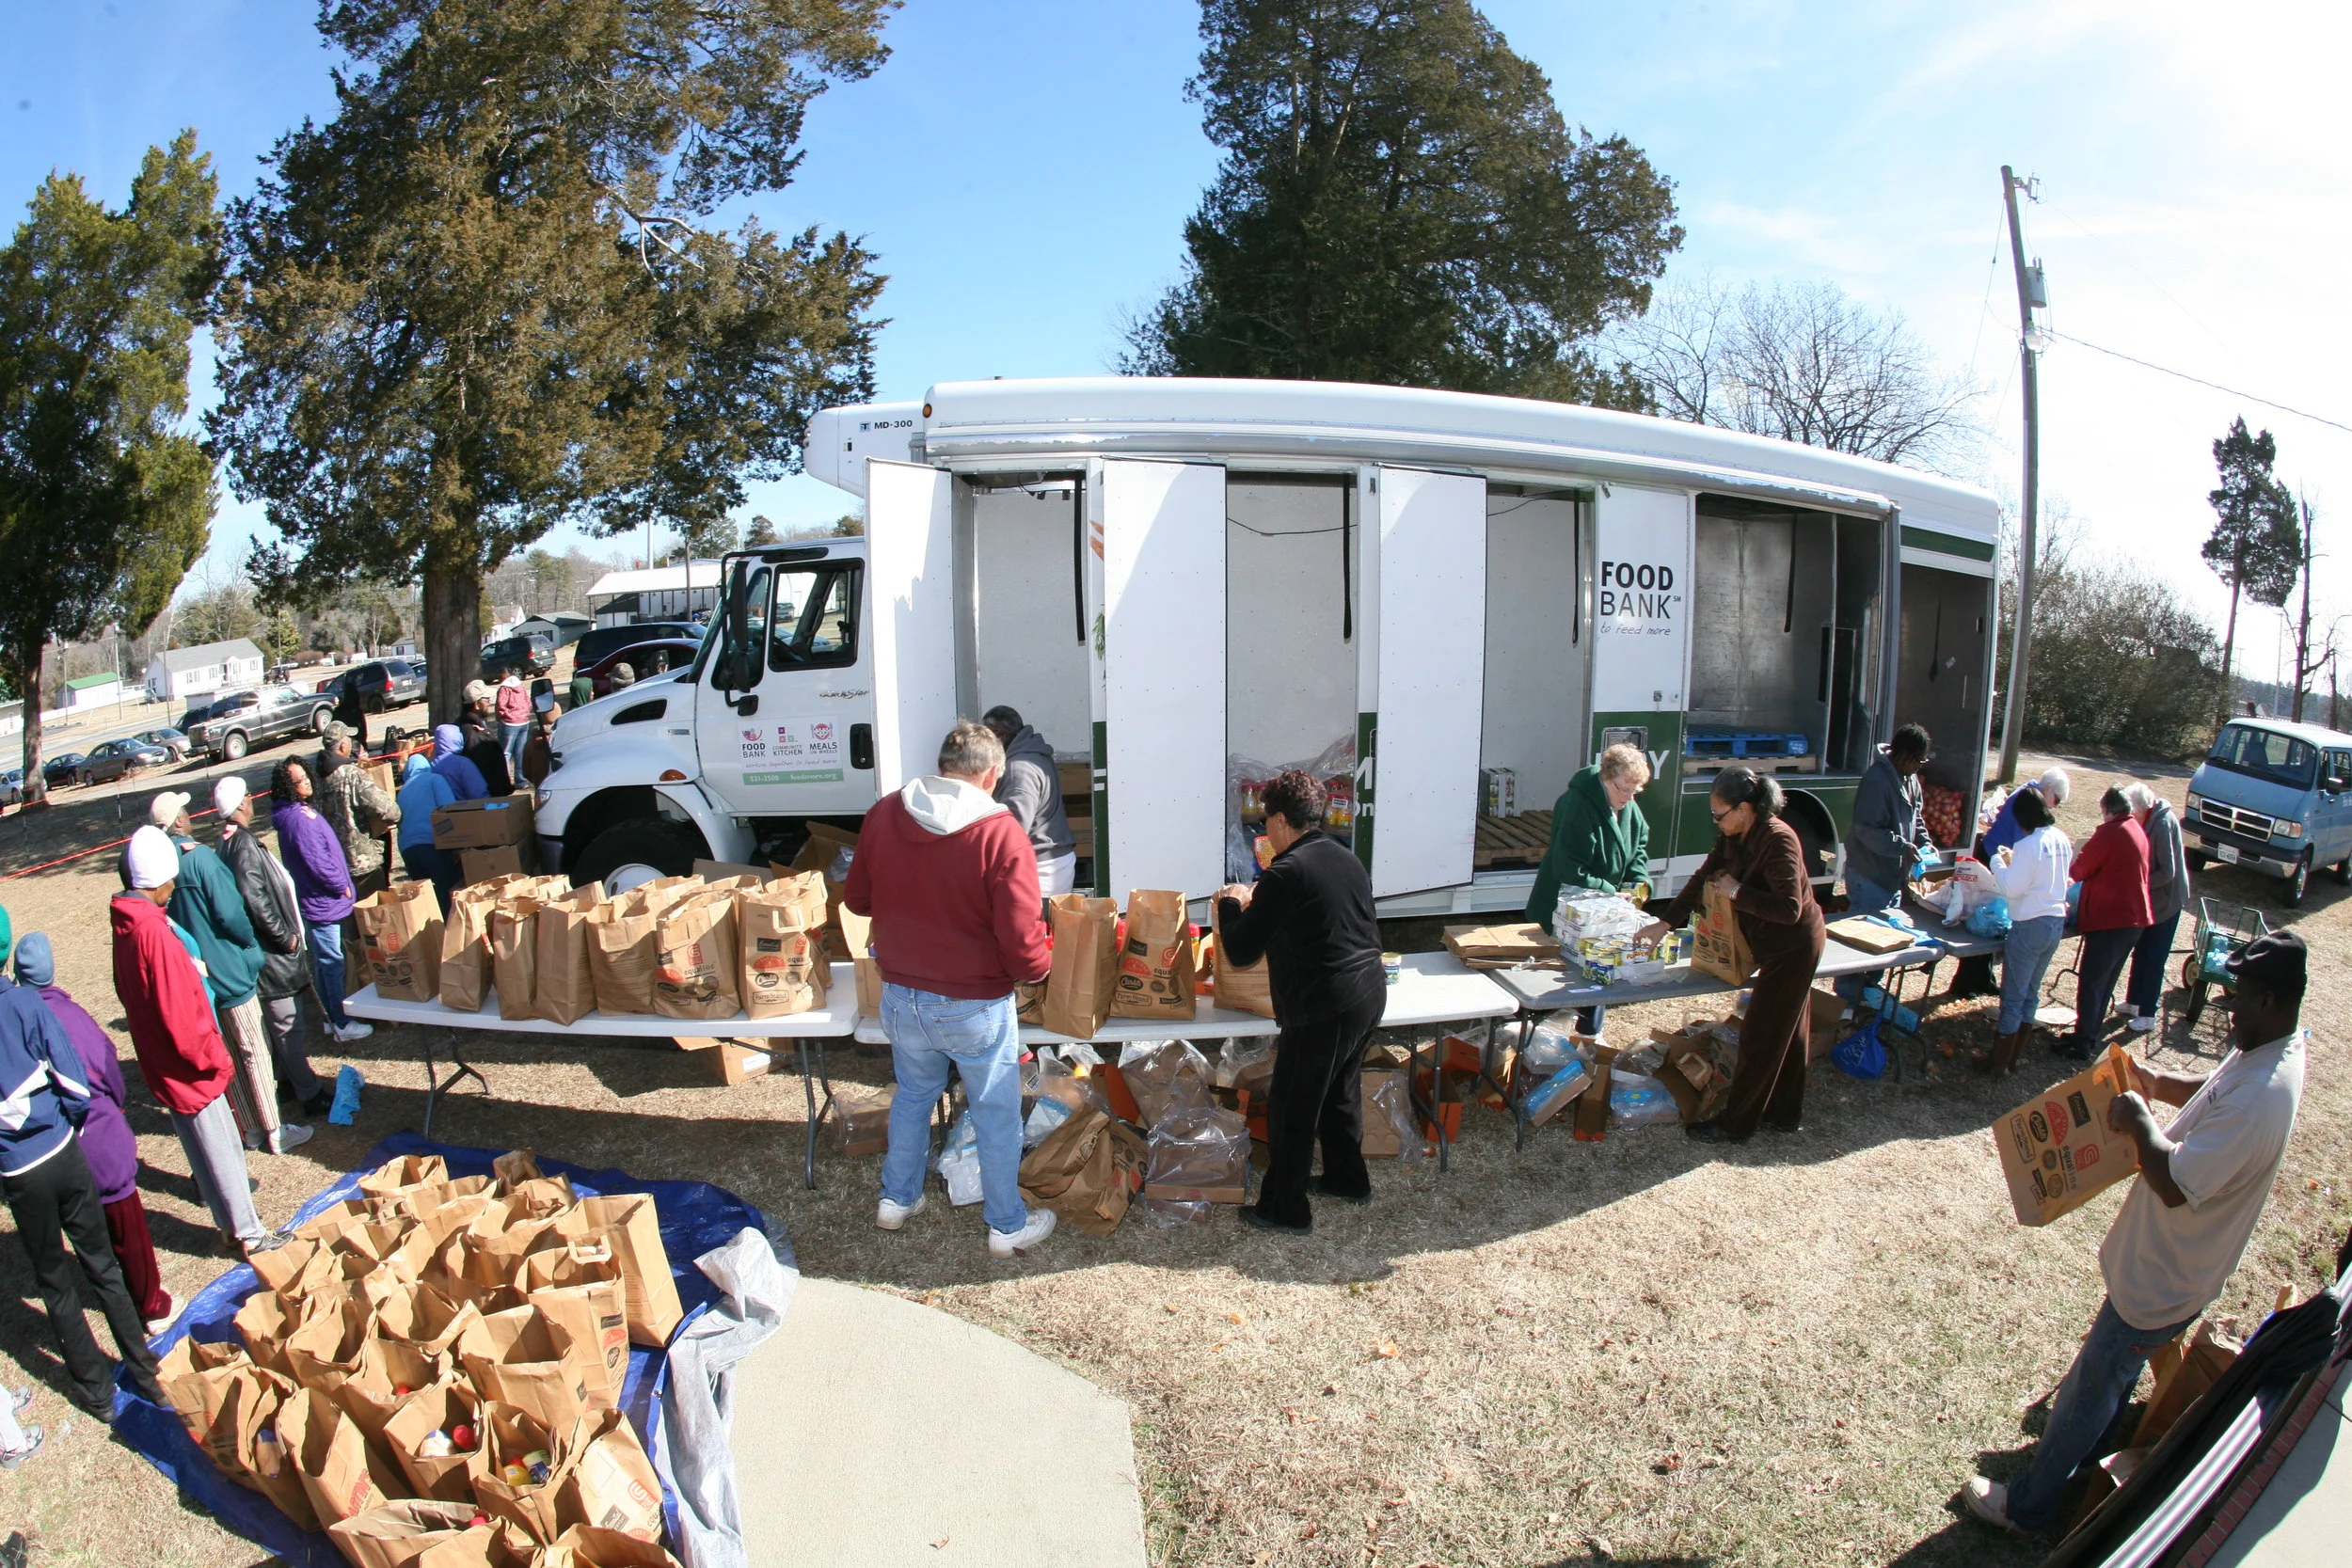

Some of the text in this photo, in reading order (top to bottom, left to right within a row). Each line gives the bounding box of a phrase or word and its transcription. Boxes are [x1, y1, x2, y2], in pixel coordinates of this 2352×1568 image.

[874, 420, 913, 429] MD-300
[1601, 562, 1674, 591] FOOD
[1600, 591, 1672, 619] BANK
[1600, 622, 1612, 634] to
[1646, 626, 1671, 636] more
[742, 742, 766, 751] FOOD
[2062, 1146, 2078, 1190] equaline
